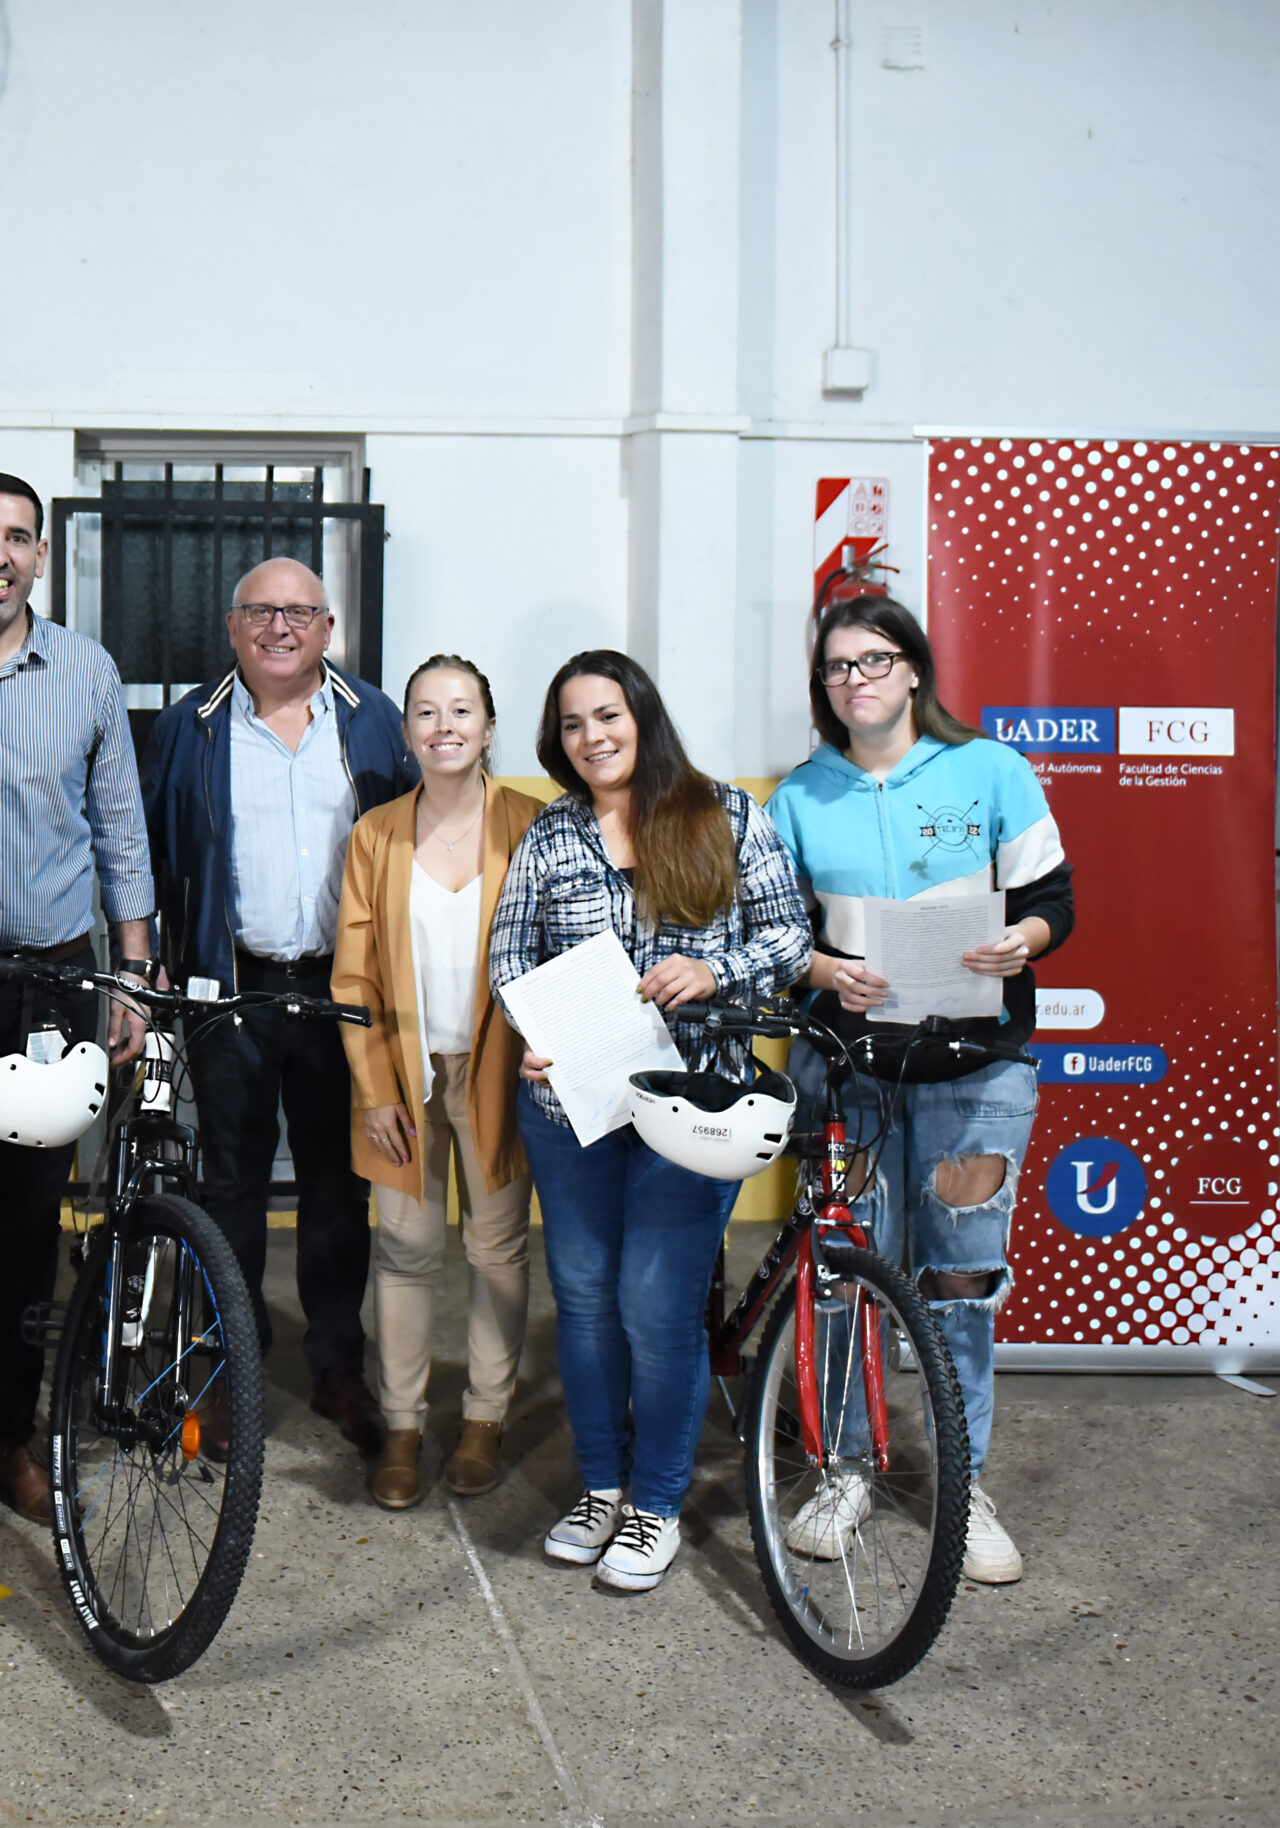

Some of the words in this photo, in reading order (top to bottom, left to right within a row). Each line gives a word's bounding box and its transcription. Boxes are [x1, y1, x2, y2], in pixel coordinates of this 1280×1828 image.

[995, 718, 1100, 743] UADER
[1146, 720, 1210, 743] FCG
[1047, 762, 1102, 773] Autónoma
[1119, 763, 1162, 774] Facultad
[1164, 763, 1178, 774] de
[1181, 763, 1223, 775] Ciencias
[1119, 775, 1132, 786] de
[1134, 775, 1143, 786] la
[1145, 775, 1186, 786] Gestión
[1088, 1056, 1152, 1072] UaderFCG
[692, 1125, 728, 1137] 268957
[1197, 1177, 1242, 1195] FCG
[69, 1580, 86, 1605] GOAT
[79, 1605, 100, 1631] BILLY
